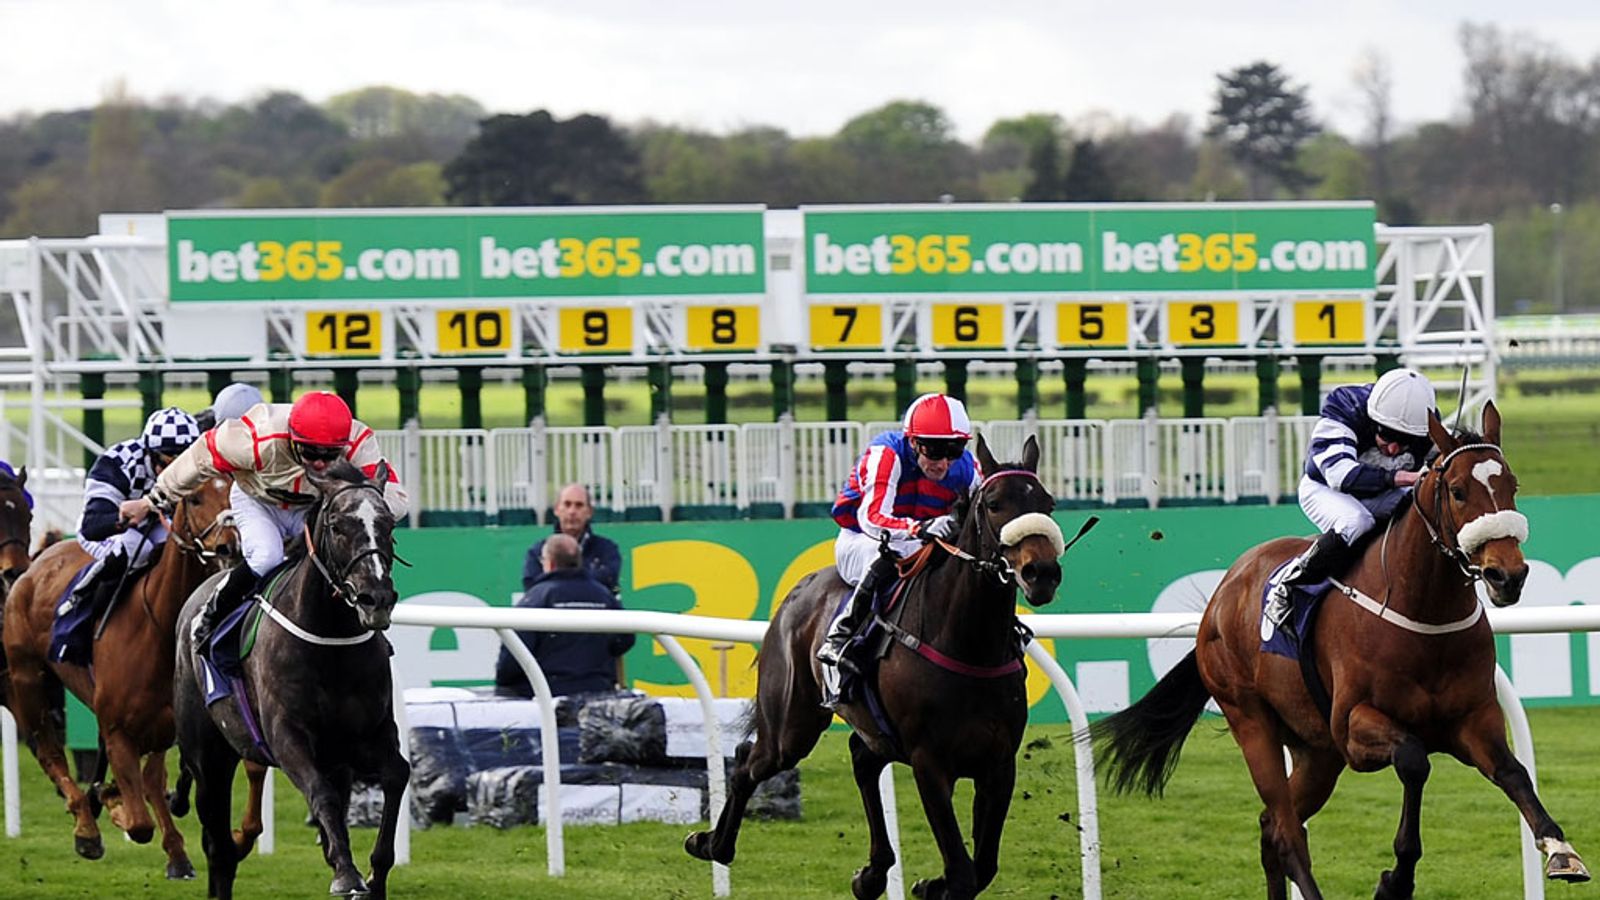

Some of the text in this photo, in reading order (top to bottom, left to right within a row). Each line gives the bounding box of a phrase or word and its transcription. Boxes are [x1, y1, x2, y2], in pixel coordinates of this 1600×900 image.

[177, 237, 756, 283] bet365.com bet365.com
[813, 231, 1367, 275] bet365.com bet365.com
[318, 313, 372, 350] 12
[449, 312, 502, 348] 10
[583, 310, 609, 346] 9
[711, 308, 737, 344] 8
[833, 307, 858, 342] 7
[954, 307, 979, 342] 6
[1079, 305, 1104, 341] 5
[1190, 307, 1215, 341] 3
[1318, 305, 1336, 339] 1
